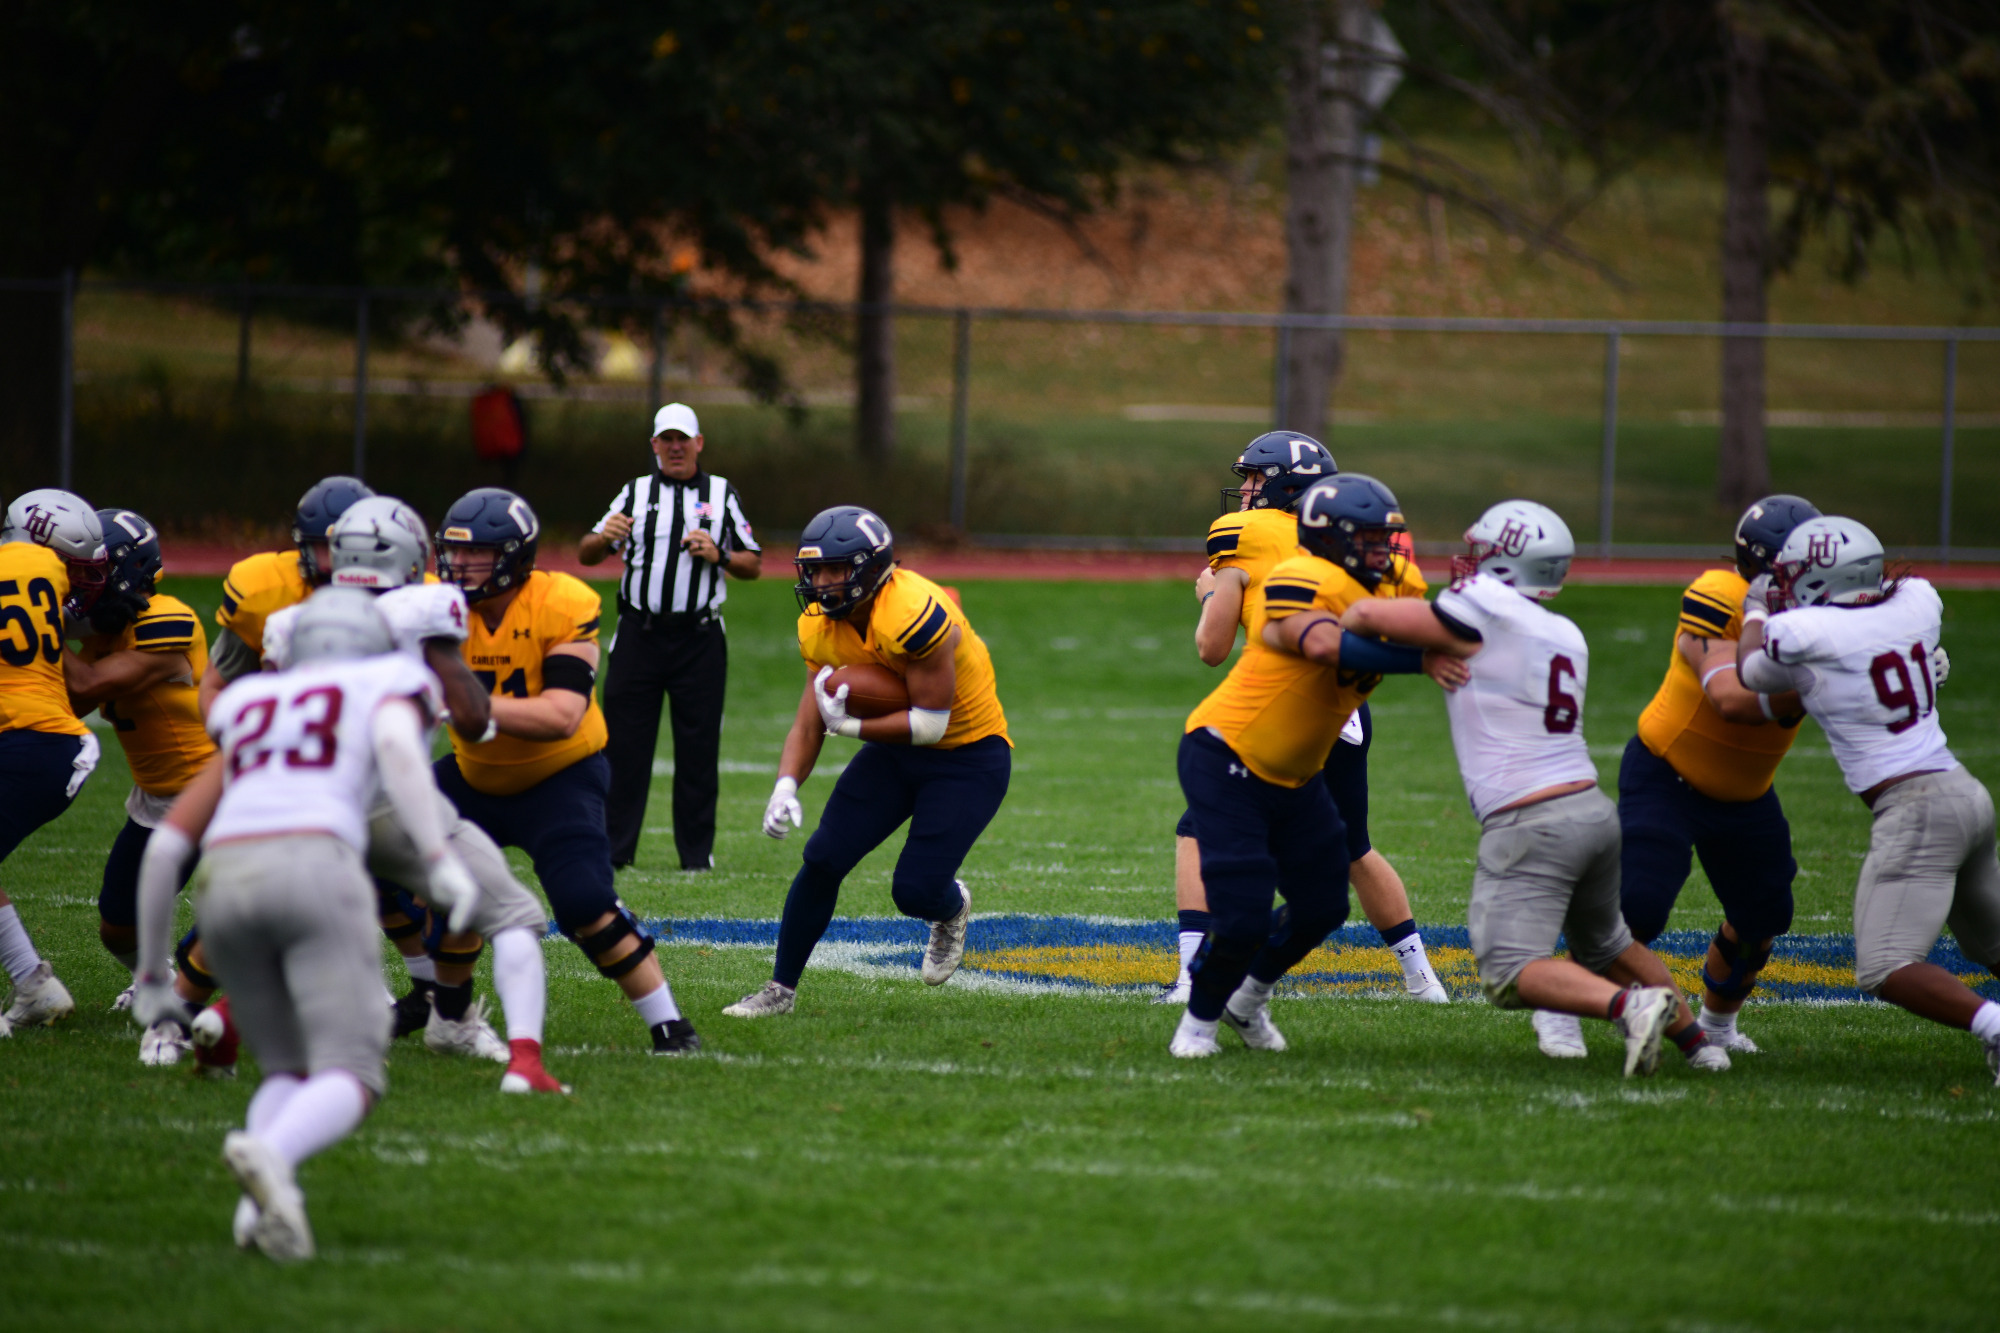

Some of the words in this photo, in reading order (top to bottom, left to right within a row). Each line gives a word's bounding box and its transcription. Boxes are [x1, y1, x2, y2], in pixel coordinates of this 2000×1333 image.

[1302, 486, 1338, 527] C
[0, 577, 64, 666] 53
[471, 655, 511, 665] CARLETON
[1543, 653, 1579, 734] 6
[1868, 640, 1934, 735] 91
[231, 684, 344, 781] 23
